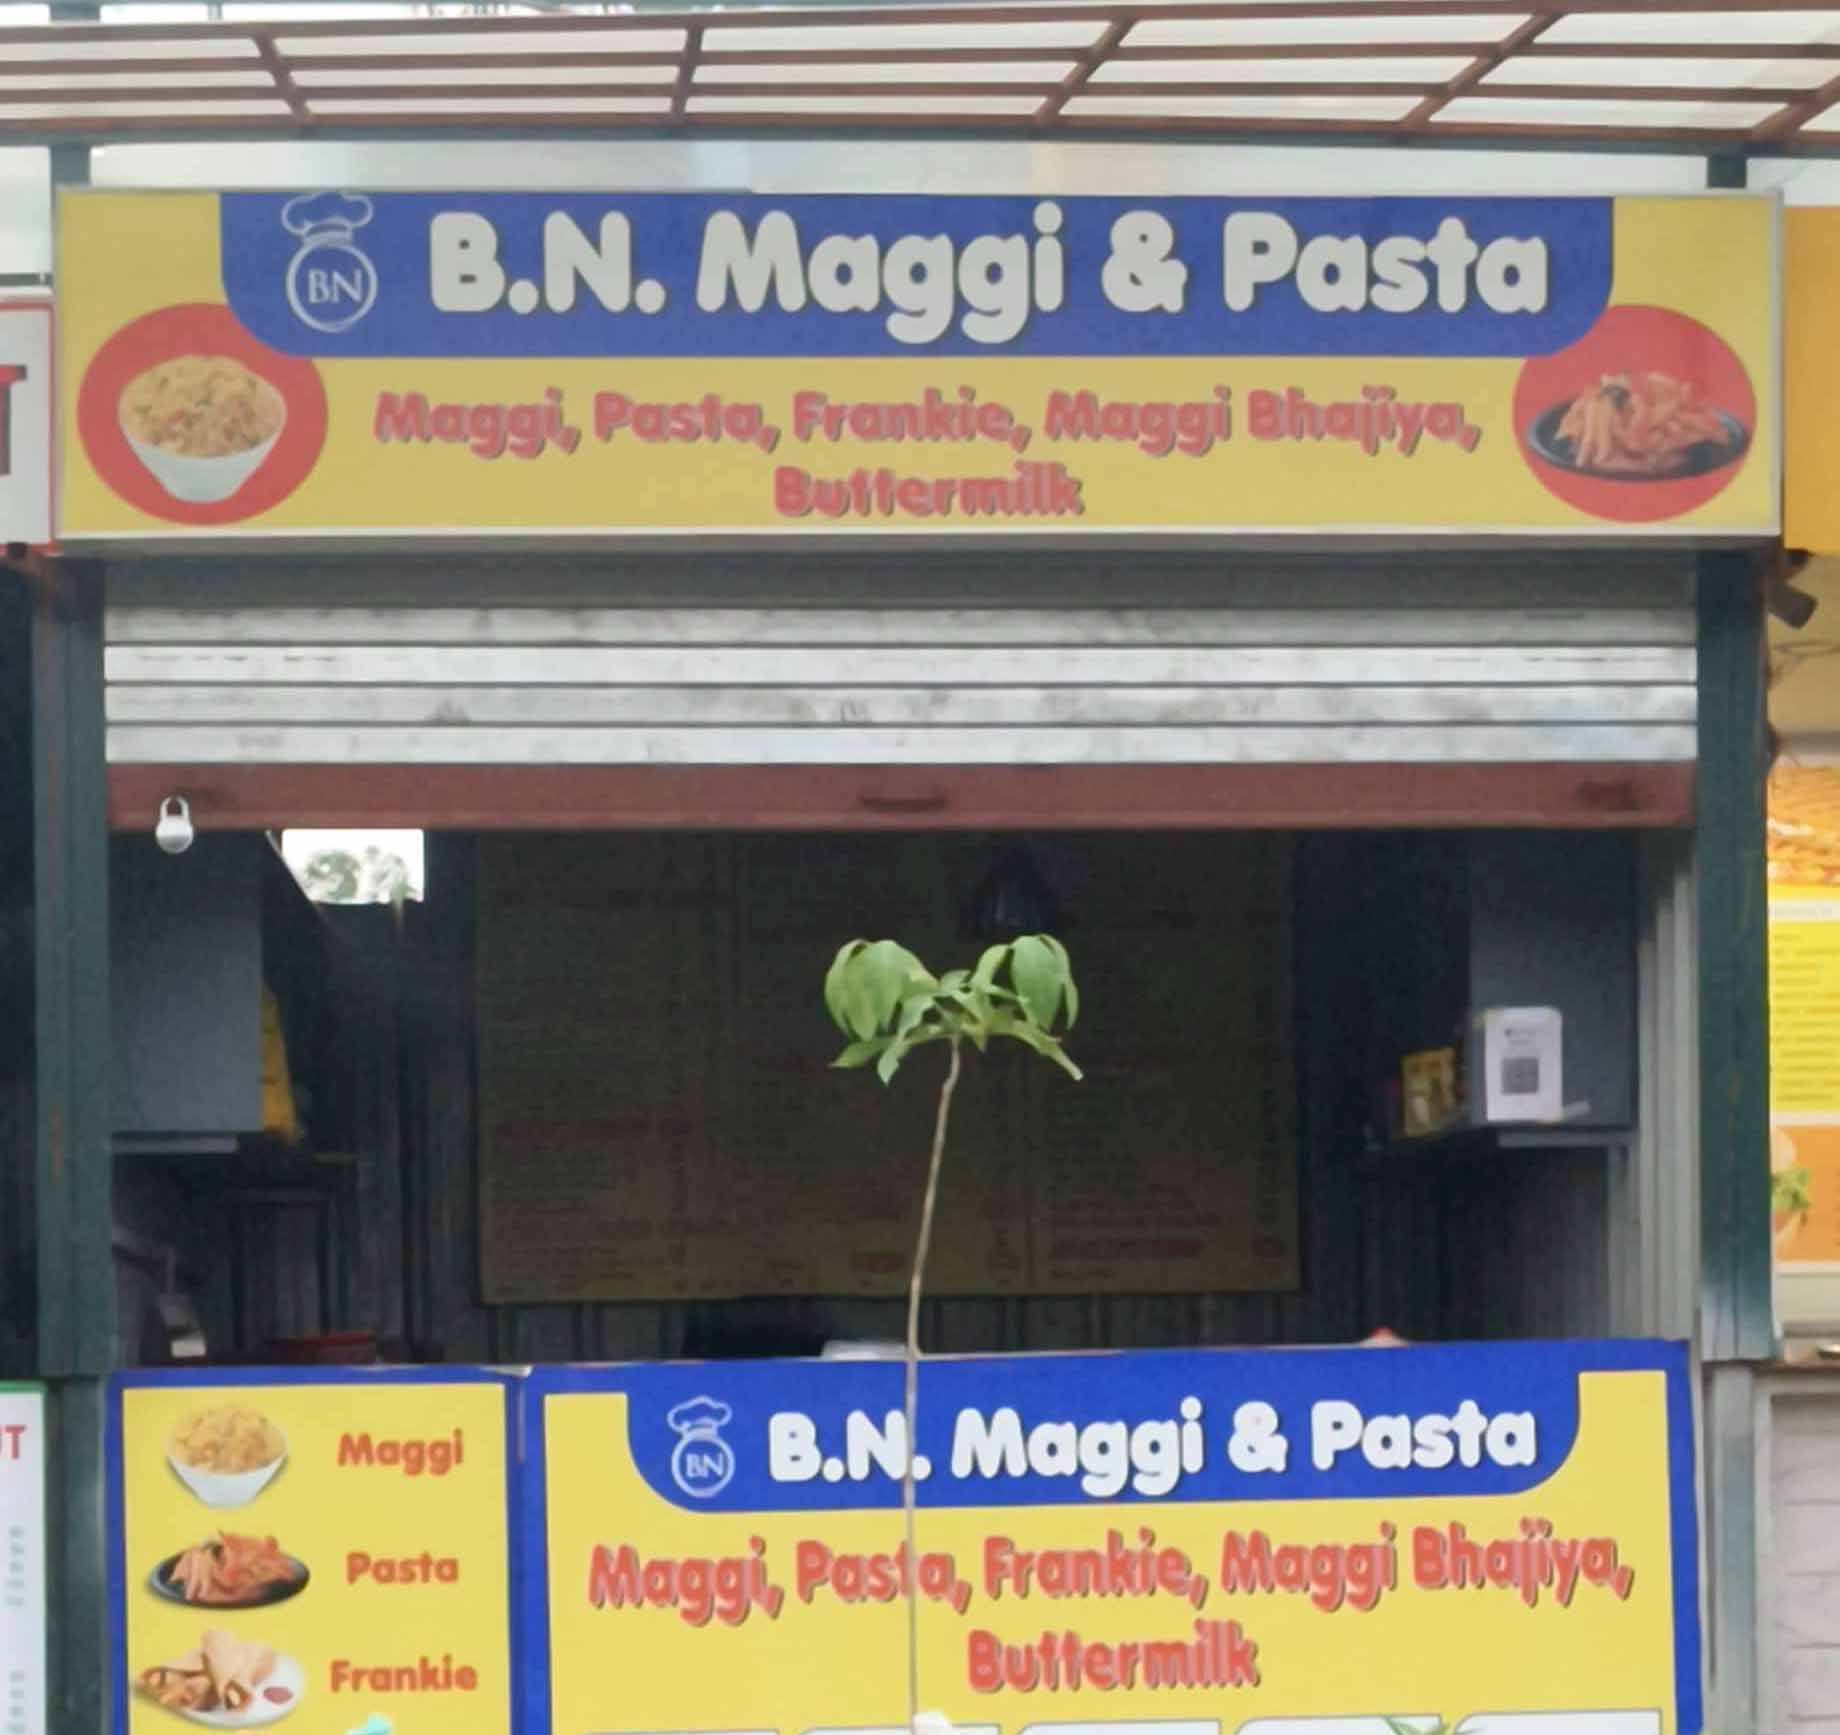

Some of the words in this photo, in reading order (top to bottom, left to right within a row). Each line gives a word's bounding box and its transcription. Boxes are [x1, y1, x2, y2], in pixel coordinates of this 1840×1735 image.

[307, 267, 364, 306] BN
[429, 209, 667, 315] B.N.
[695, 198, 1065, 345] Maggi
[1100, 210, 1190, 314] &
[1221, 211, 1550, 315] Pasta
[372, 387, 582, 460] Maggi,
[592, 391, 781, 454] Pasta,
[791, 387, 1031, 453] Frankie,
[1043, 386, 1232, 457] Maggi
[1247, 386, 1482, 456] Bhajiya,
[772, 462, 1085, 518] Buttermilk
[336, 1428, 465, 1477] Maggi
[685, 1452, 727, 1478] BN
[767, 1410, 933, 1482] B.N.
[951, 1396, 1204, 1497] Maggi
[1227, 1400, 1289, 1473] &
[1310, 1399, 1537, 1471] Pasta
[345, 1551, 460, 1586] Pasta
[588, 1536, 784, 1627] Maggi,
[794, 1538, 972, 1615] Pasta,
[982, 1526, 1207, 1610] Frankie,
[1220, 1521, 1396, 1613] Maggi
[1411, 1516, 1634, 1608] Bhajiya,
[328, 1654, 478, 1693] Frankie
[966, 1617, 1261, 1694] Buttermilk
